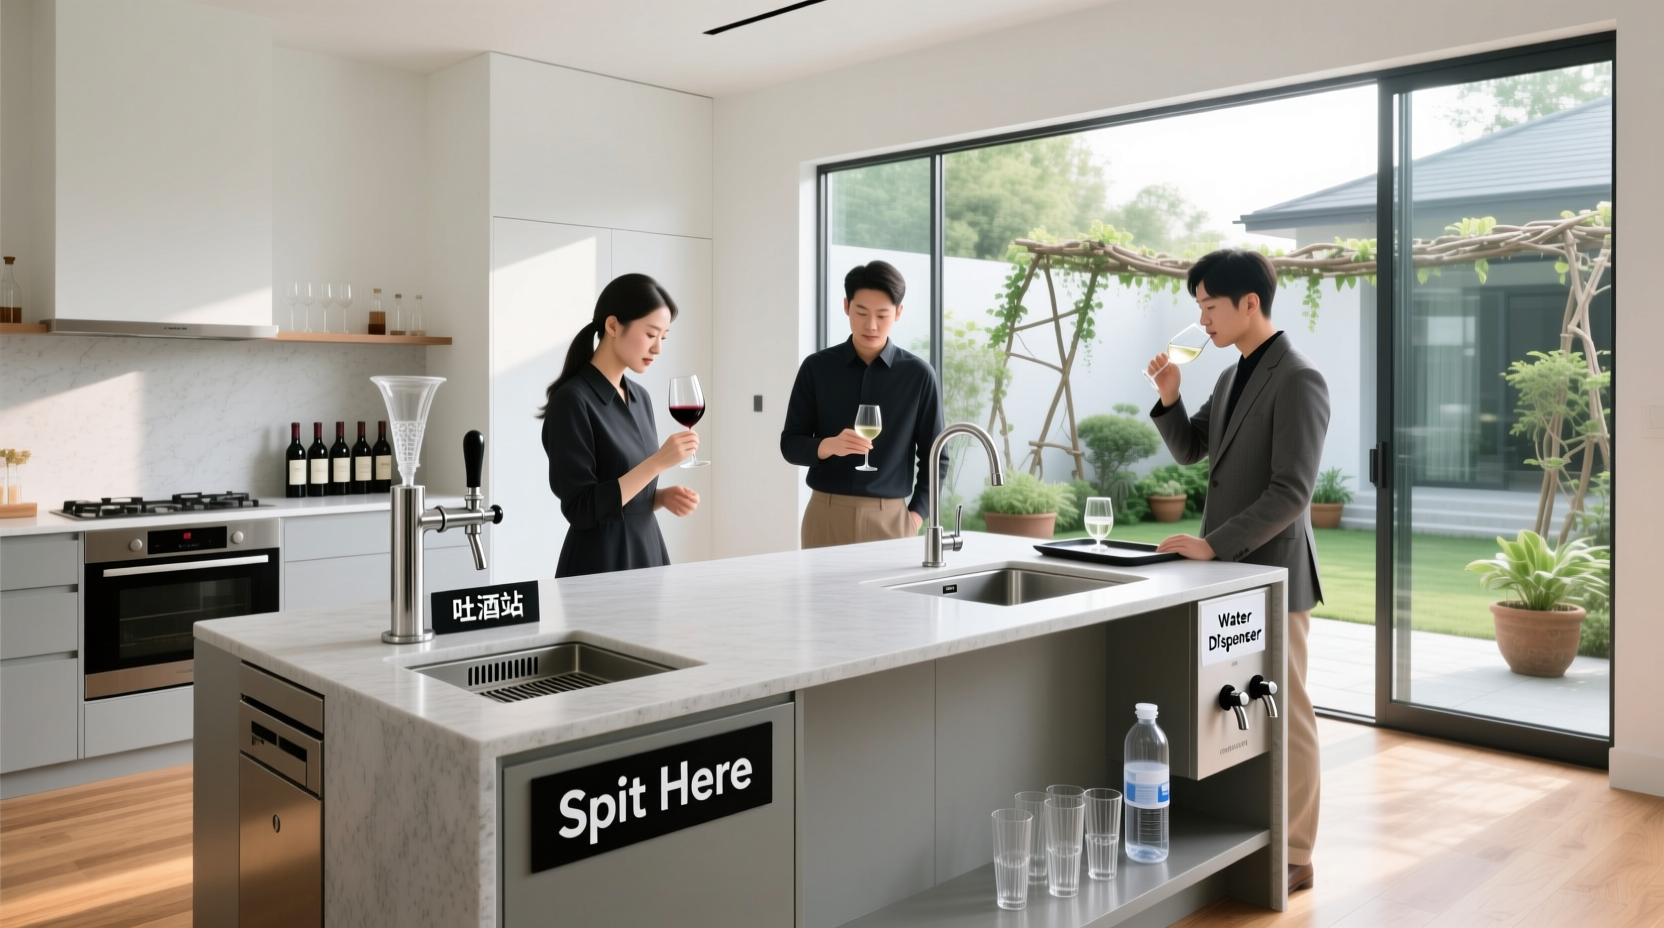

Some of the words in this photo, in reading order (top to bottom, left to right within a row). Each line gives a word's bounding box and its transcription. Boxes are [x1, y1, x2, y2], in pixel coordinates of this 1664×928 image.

[452, 590, 523, 622] 吐酒站
[1218, 611, 1252, 628] Water
[1208, 628, 1262, 653] Dispenser
[558, 775, 647, 845] Spit
[660, 757, 753, 811] Here
